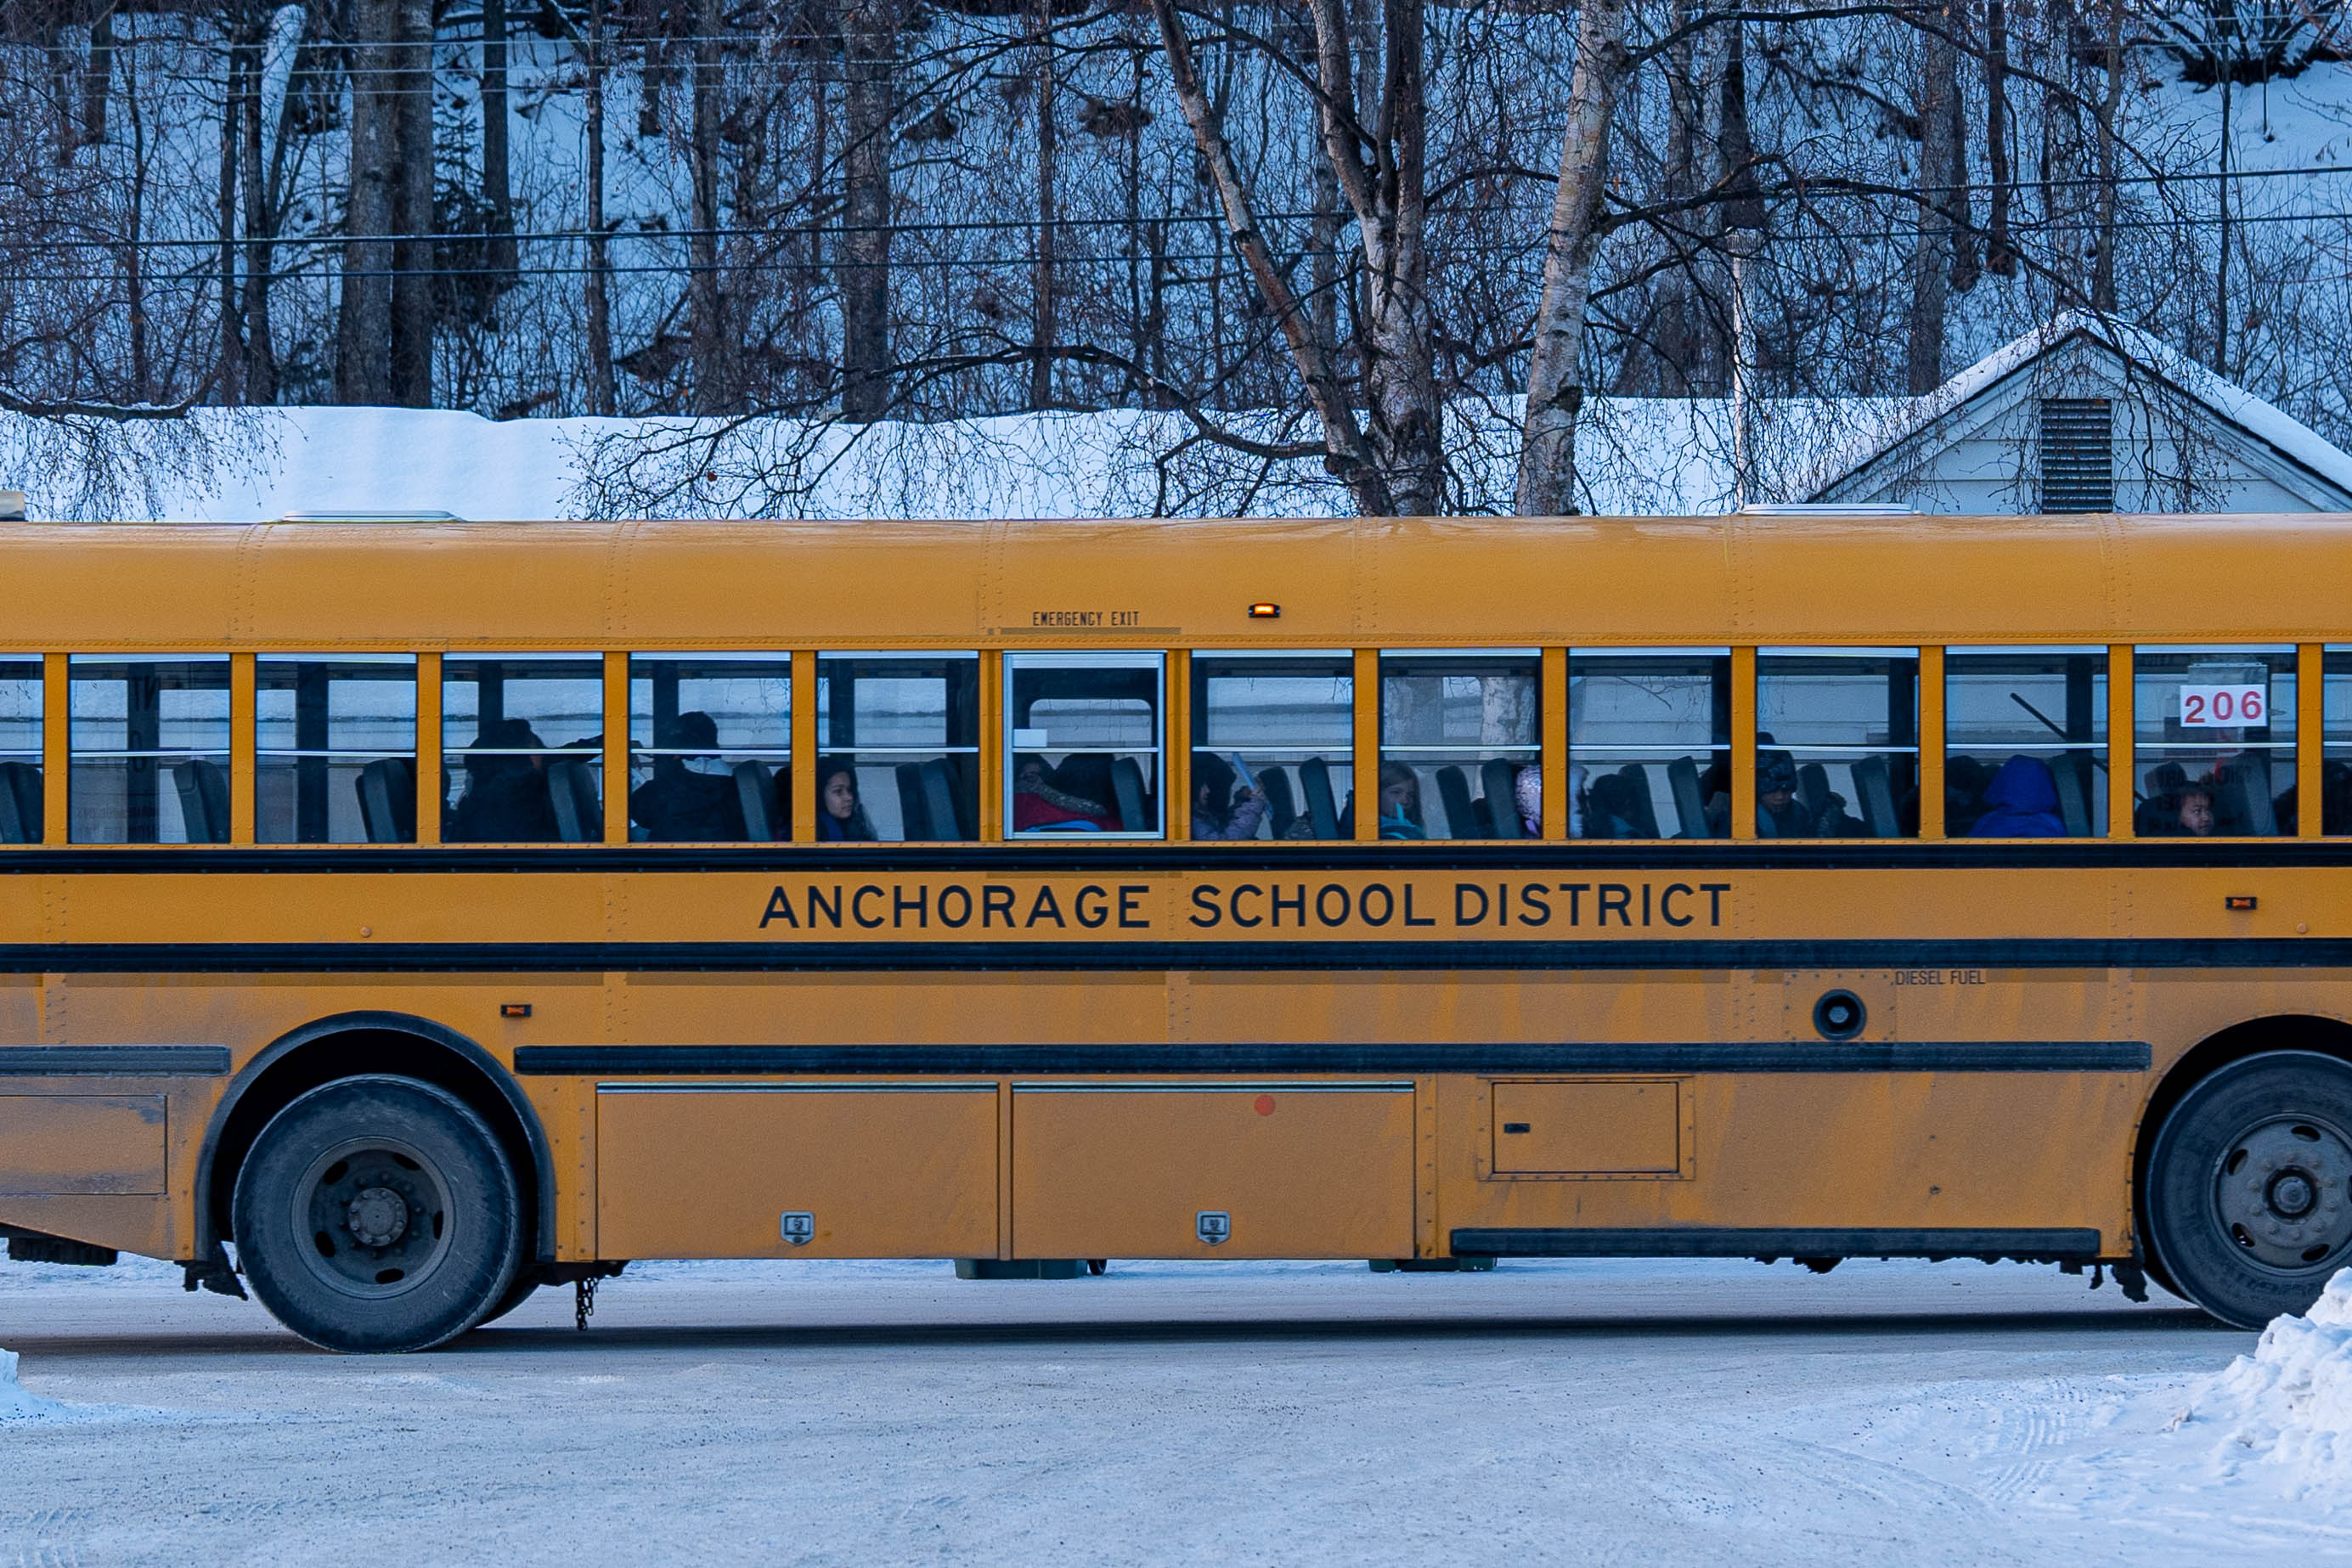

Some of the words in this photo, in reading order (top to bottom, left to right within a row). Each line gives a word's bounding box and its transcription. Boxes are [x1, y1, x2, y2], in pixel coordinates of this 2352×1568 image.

[1032, 611, 1103, 627] EMERGENCY
[1111, 611, 1139, 627] EXIT
[2185, 690, 2263, 724] 206
[759, 884, 1150, 929] ANCHORAGE
[1188, 883, 1436, 928] SCHOOL
[1455, 883, 1731, 928] DISTRICT
[1895, 970, 1944, 985] DIESEL
[1950, 970, 1985, 985] FUEL
